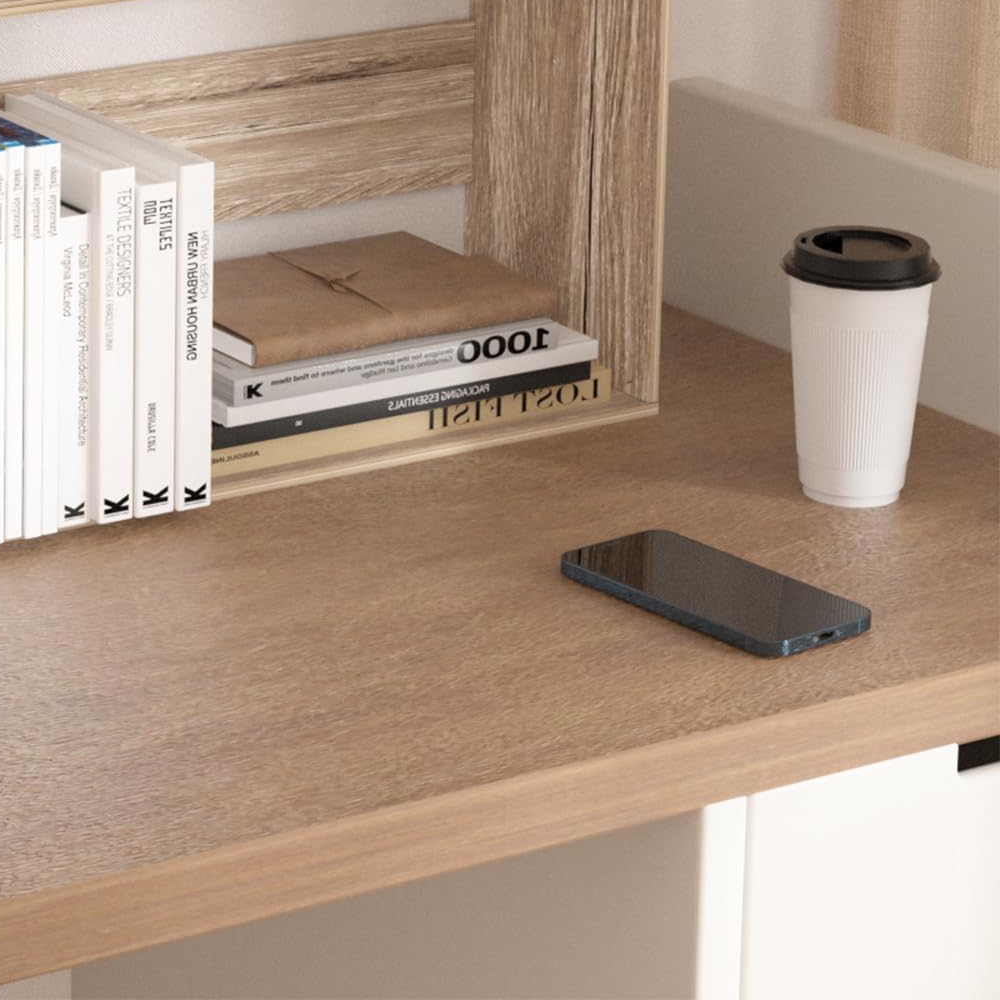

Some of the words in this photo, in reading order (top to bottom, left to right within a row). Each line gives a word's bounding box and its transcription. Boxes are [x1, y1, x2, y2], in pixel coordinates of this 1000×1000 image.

[116, 187, 132, 233] TEXTILE
[159, 198, 173, 251] TEXTILES
[60, 247, 72, 280] Virginia
[78, 243, 89, 269] Detail
[78, 271, 89, 279] in
[116, 234, 132, 297] DESIGNERS
[63, 282, 73, 317] McLeod
[76, 281, 89, 343] Contemporary
[78, 345, 88, 393] Residential
[246, 382, 264, 399] K
[77, 395, 88, 446] Architecture
